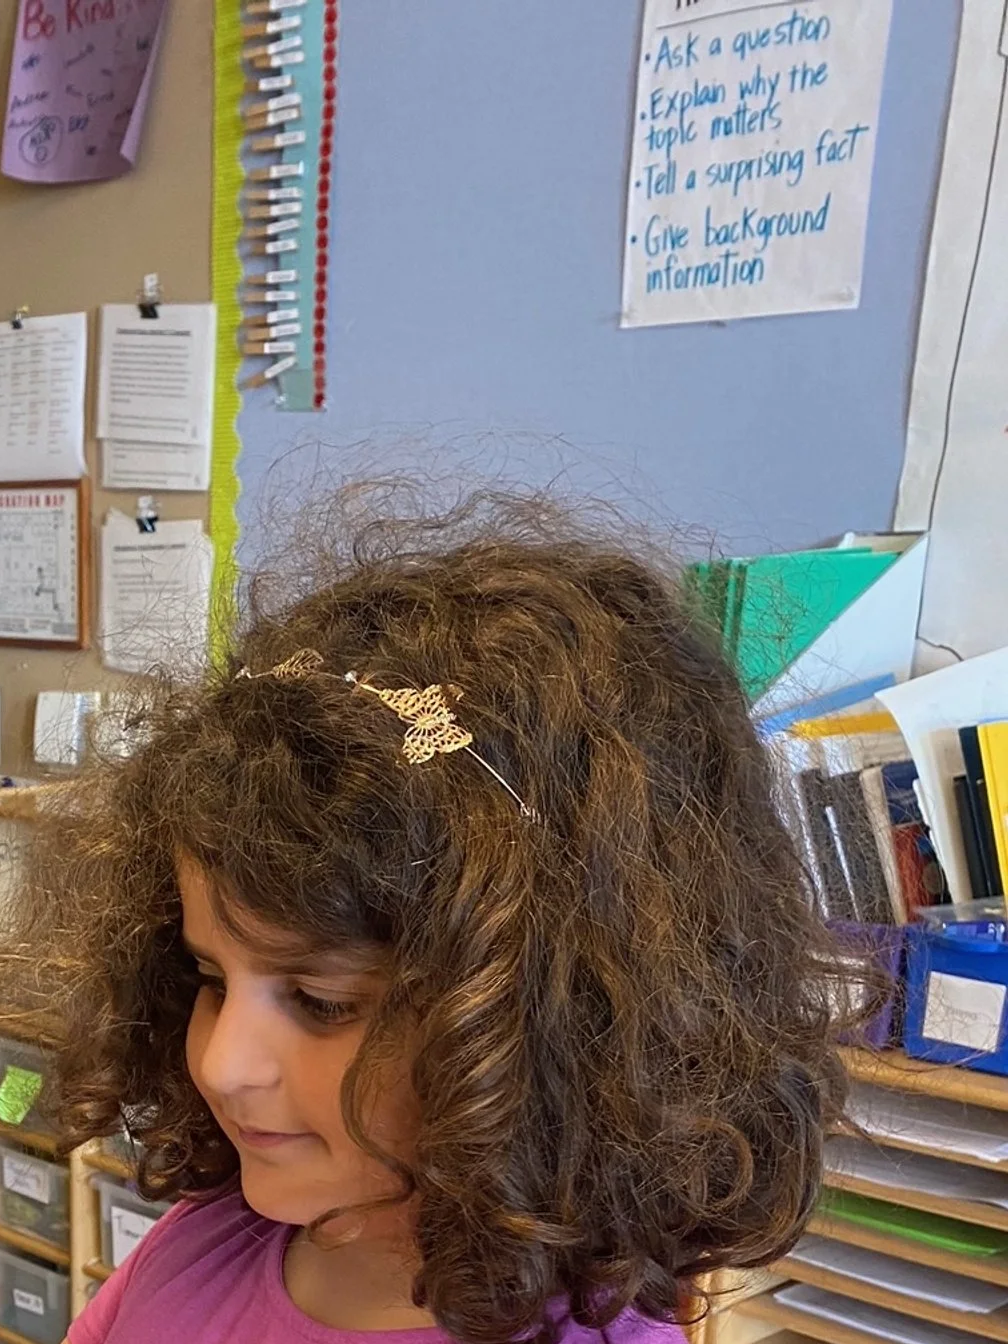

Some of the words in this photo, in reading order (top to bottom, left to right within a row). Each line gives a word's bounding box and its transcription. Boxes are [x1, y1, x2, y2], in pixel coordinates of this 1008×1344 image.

[22, 0, 55, 41] Be
[653, 31, 699, 72] Ask
[709, 37, 722, 55] a
[732, 9, 831, 62] question
[650, 79, 726, 121] Explain
[739, 65, 781, 100] why
[788, 60, 828, 93] the
[645, 121, 697, 158] topic
[710, 101, 782, 140] matters
[644, 157, 676, 199] Tell
[686, 171, 696, 190] a
[706, 147, 805, 198] surprising
[814, 122, 870, 166] fact
[644, 212, 689, 257] Give
[704, 192, 832, 252] background
[646, 250, 765, 294] information
